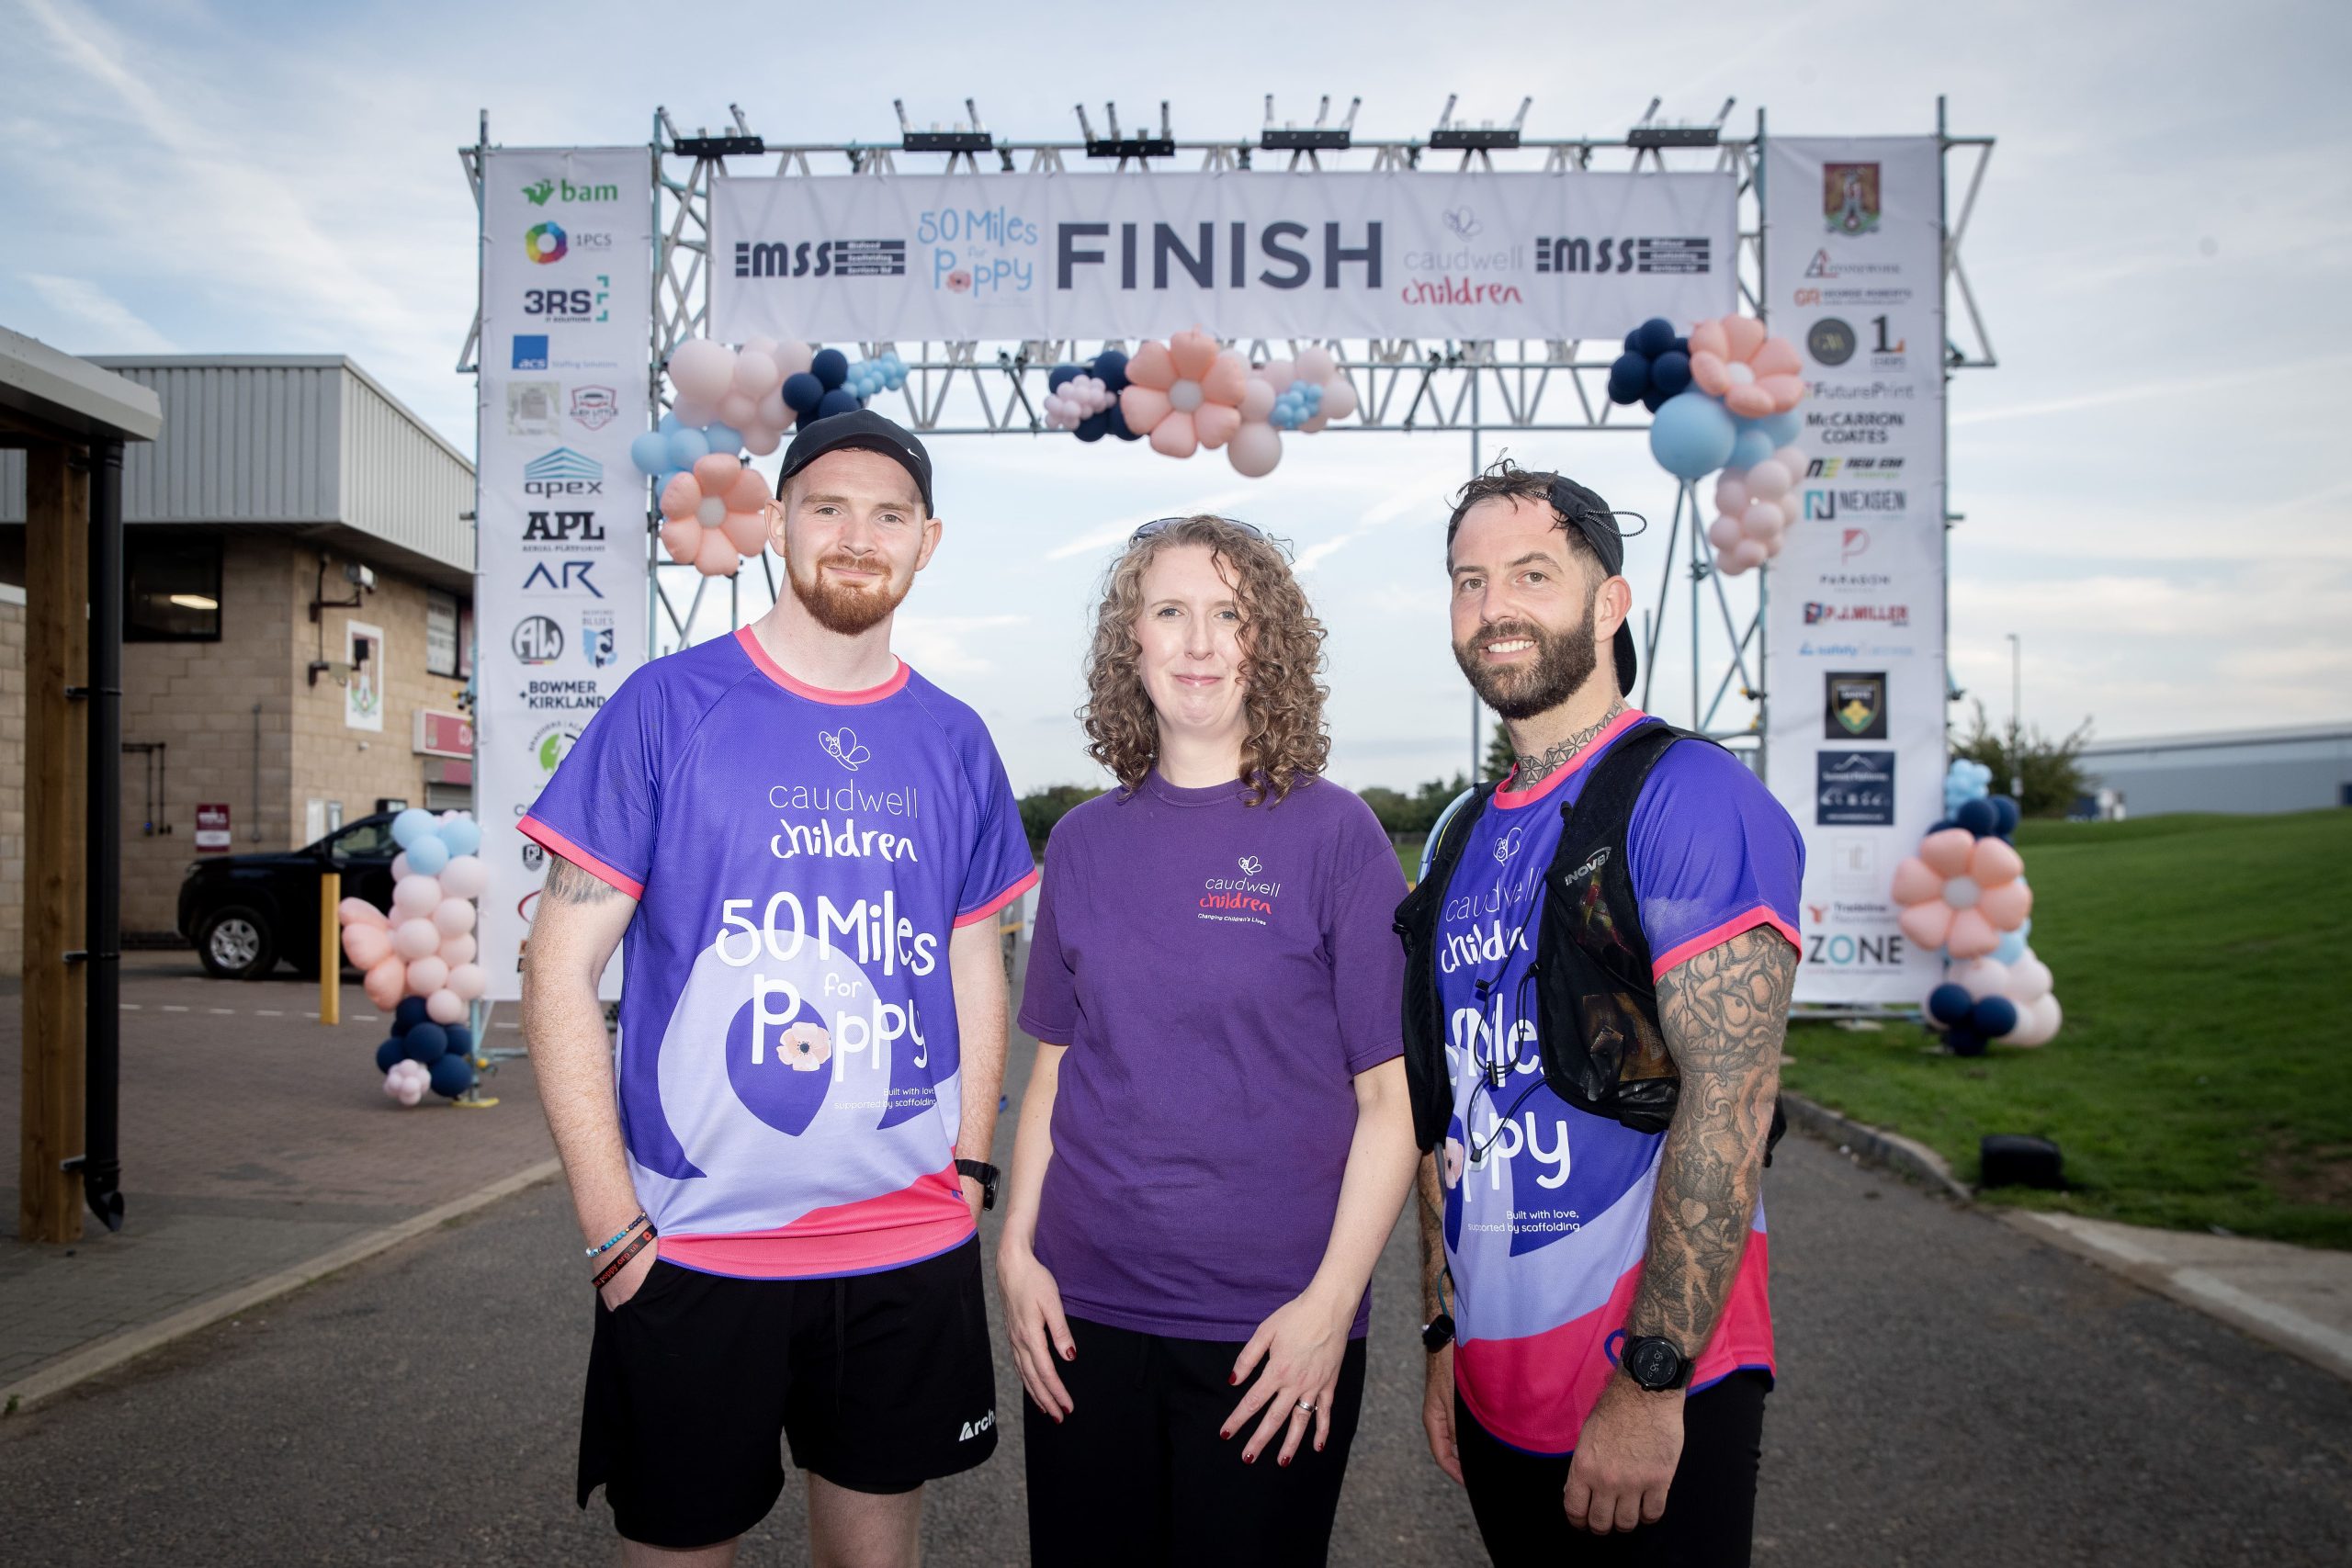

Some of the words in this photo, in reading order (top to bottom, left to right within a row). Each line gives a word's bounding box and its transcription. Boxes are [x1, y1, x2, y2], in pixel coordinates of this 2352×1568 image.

[561, 178, 618, 202] bam
[917, 208, 959, 245] 50
[966, 206, 1038, 247] Miles
[576, 233, 612, 246] 1PCS
[1057, 221, 1383, 291] FINISH
[1403, 246, 1523, 272] caudwell
[524, 289, 592, 315] 3RS
[1402, 276, 1522, 305] children
[1805, 413, 1905, 426] McCARRON
[1821, 429, 1889, 444] COATES
[524, 481, 603, 499] apex
[522, 511, 605, 540] APL
[529, 681, 597, 694] BOWMER
[529, 696, 606, 709] KIRKLAND
[769, 778, 918, 819] caudwell
[771, 818, 918, 862] children
[1204, 876, 1281, 897] caudwell
[1199, 892, 1272, 915] children
[1197, 913, 1223, 921] Changing
[1251, 917, 1267, 926] Lives
[715, 891, 806, 967] 50
[817, 890, 937, 976] Miles
[1808, 935, 1905, 964] ZONE
[823, 972, 863, 998] for
[883, 1088, 900, 1096] Built
[833, 1100, 881, 1111] supported
[883, 1100, 893, 1109] by
[1506, 1210, 1527, 1220] Built
[1529, 1210, 1551, 1219] with
[1507, 1223, 1520, 1235] by
[1521, 1222, 1580, 1233] scaffolding
[958, 1408, 995, 1442] Arch
